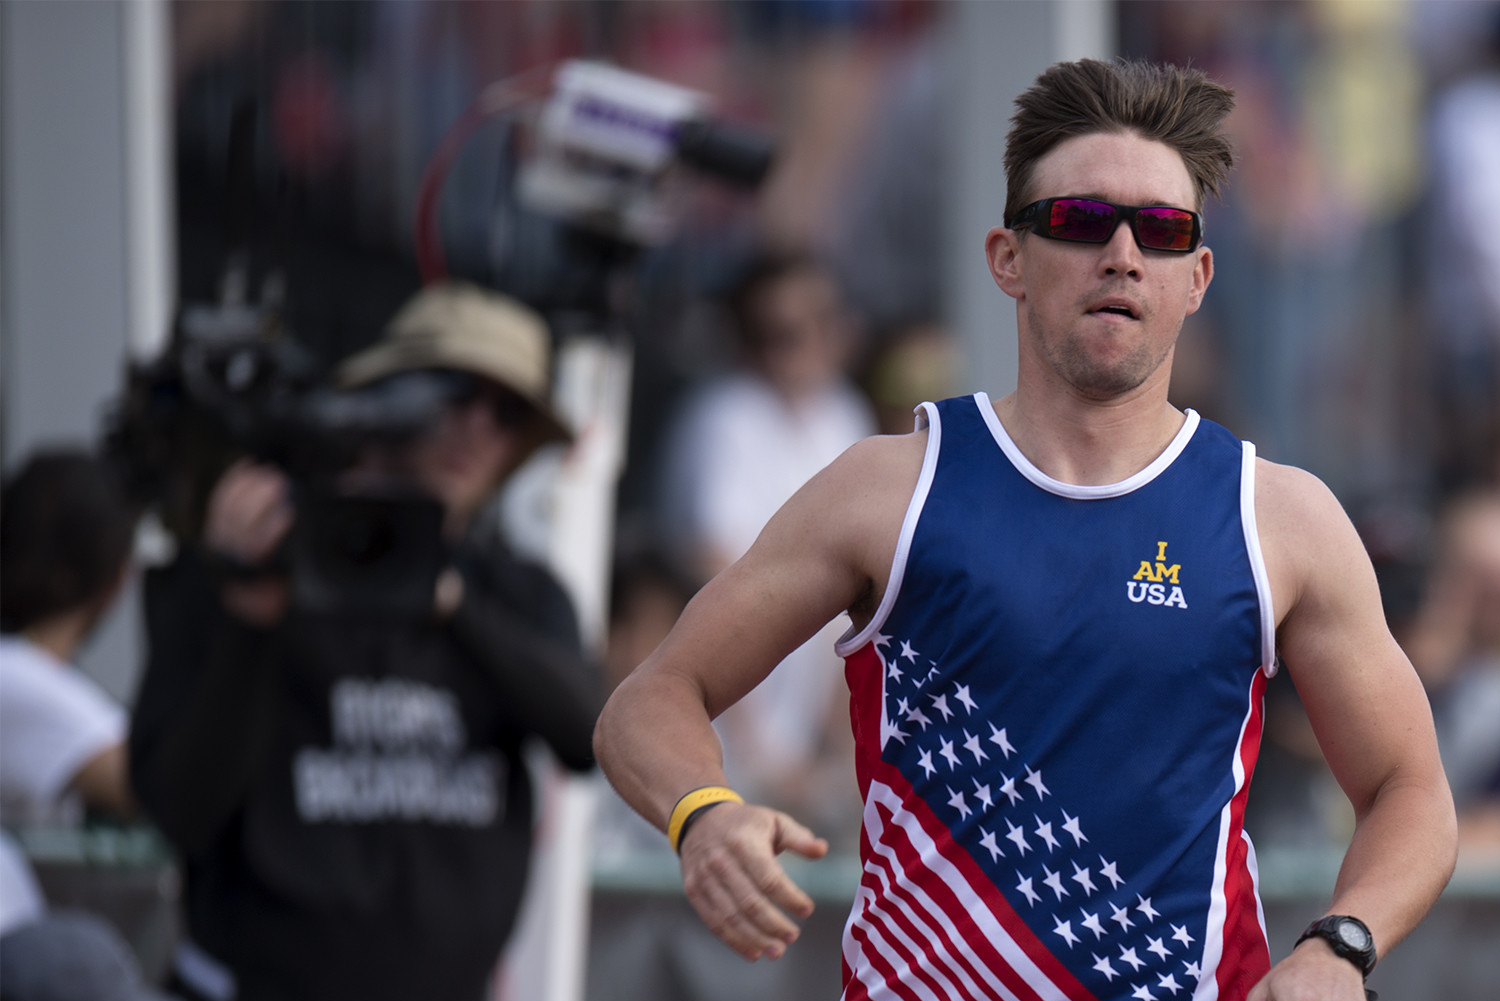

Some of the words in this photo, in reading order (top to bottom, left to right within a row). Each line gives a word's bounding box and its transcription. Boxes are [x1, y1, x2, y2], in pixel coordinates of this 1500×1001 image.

[1156, 541, 1168, 561] I
[1133, 560, 1181, 584] AM
[1126, 581, 1188, 609] USA
